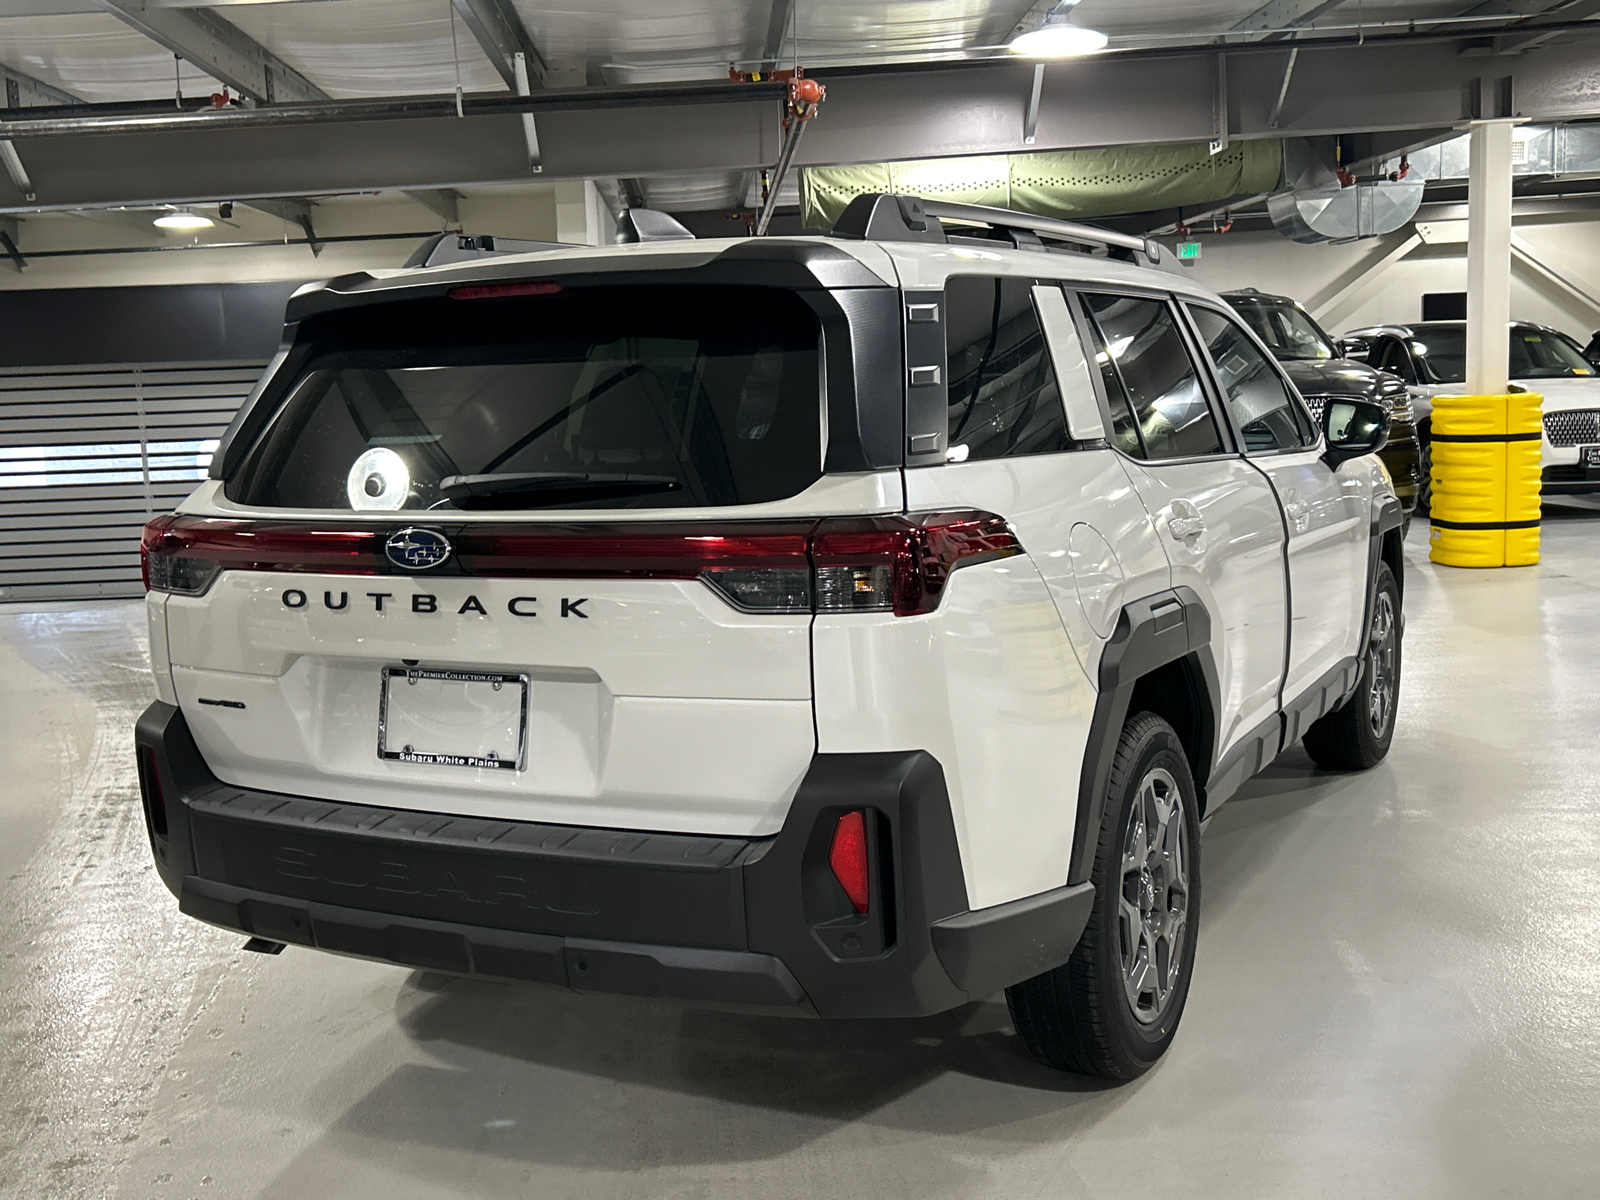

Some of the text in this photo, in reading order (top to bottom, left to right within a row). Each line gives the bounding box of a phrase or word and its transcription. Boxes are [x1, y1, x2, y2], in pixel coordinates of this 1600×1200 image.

[1181, 244, 1197, 258] EXIT
[281, 588, 589, 619] OUTBACK
[399, 752, 500, 768] Subaru White Plains
